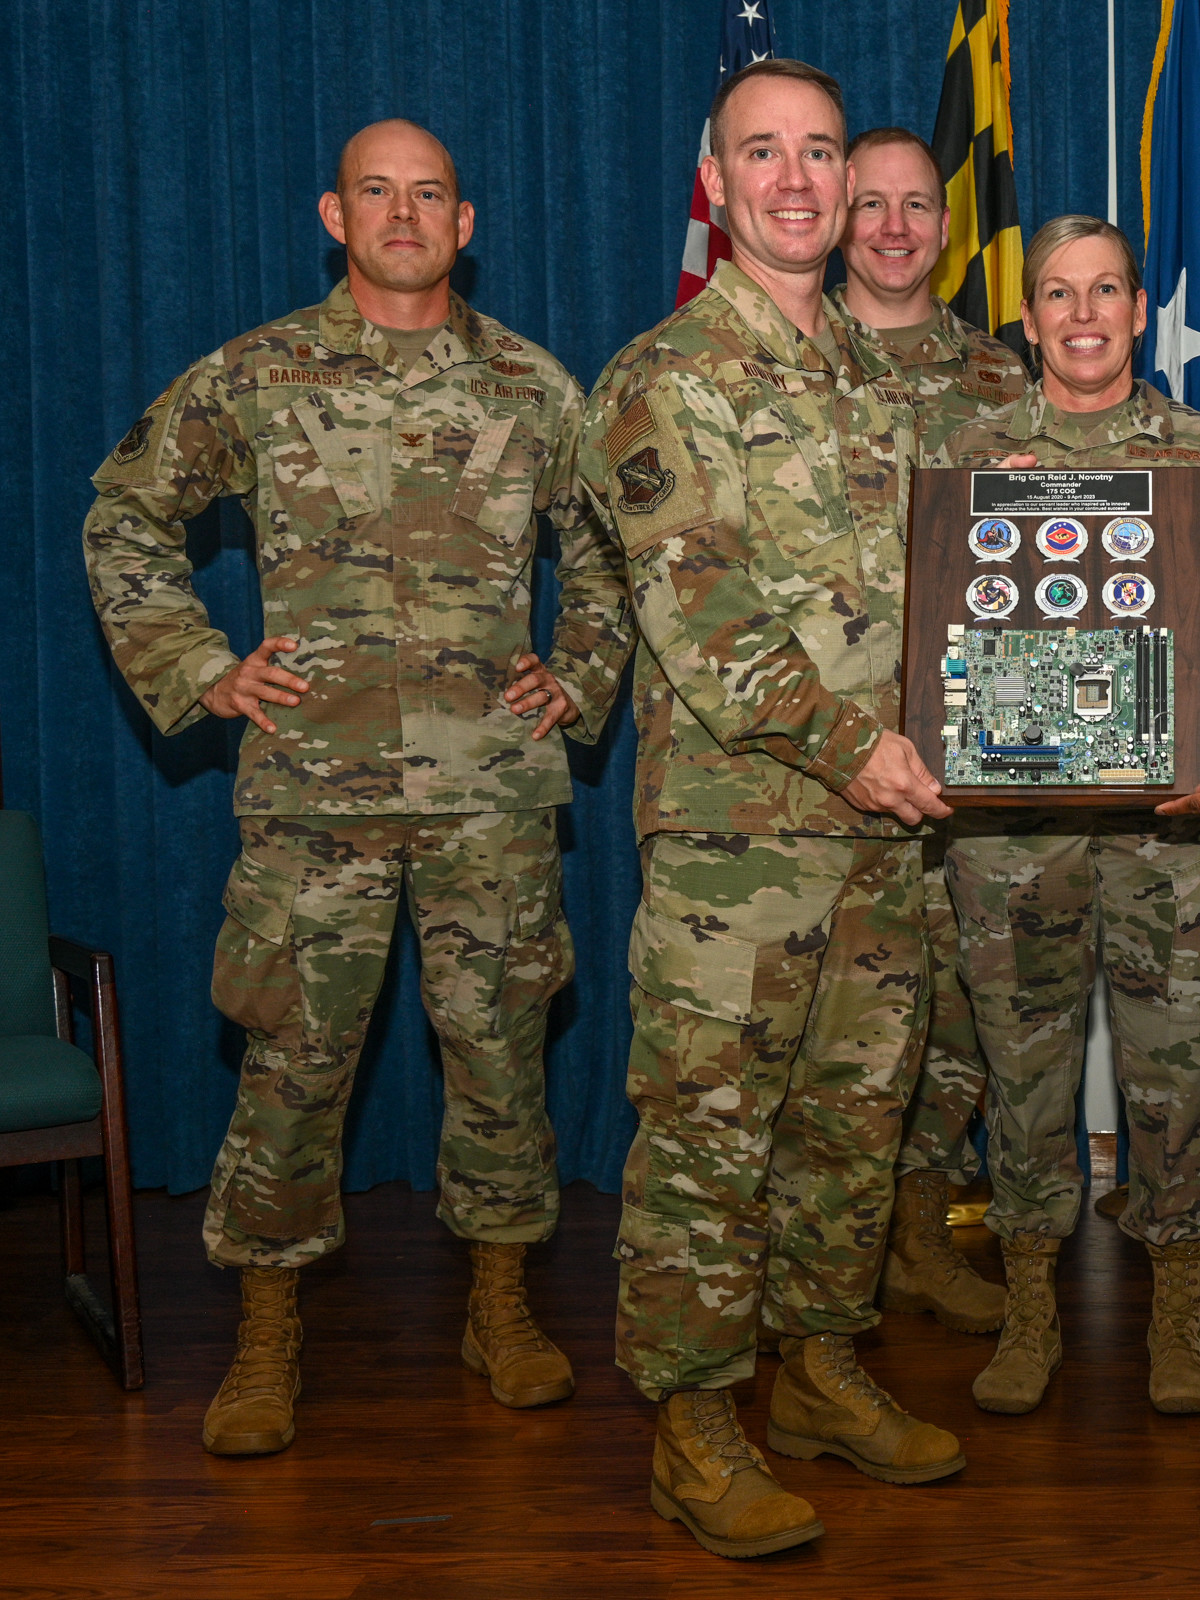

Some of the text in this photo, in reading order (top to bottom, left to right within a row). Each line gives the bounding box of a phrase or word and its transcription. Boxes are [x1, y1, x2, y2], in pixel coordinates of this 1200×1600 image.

[269, 368, 343, 385] BARRASS
[470, 378, 491, 396] U.S.
[494, 383, 514, 399] AIR
[1129, 443, 1150, 458] U.S.
[1154, 448, 1172, 459] AIR
[1008, 474, 1026, 482] Brig
[1078, 473, 1114, 482] Novotny
[1061, 731, 1085, 740] DELL
